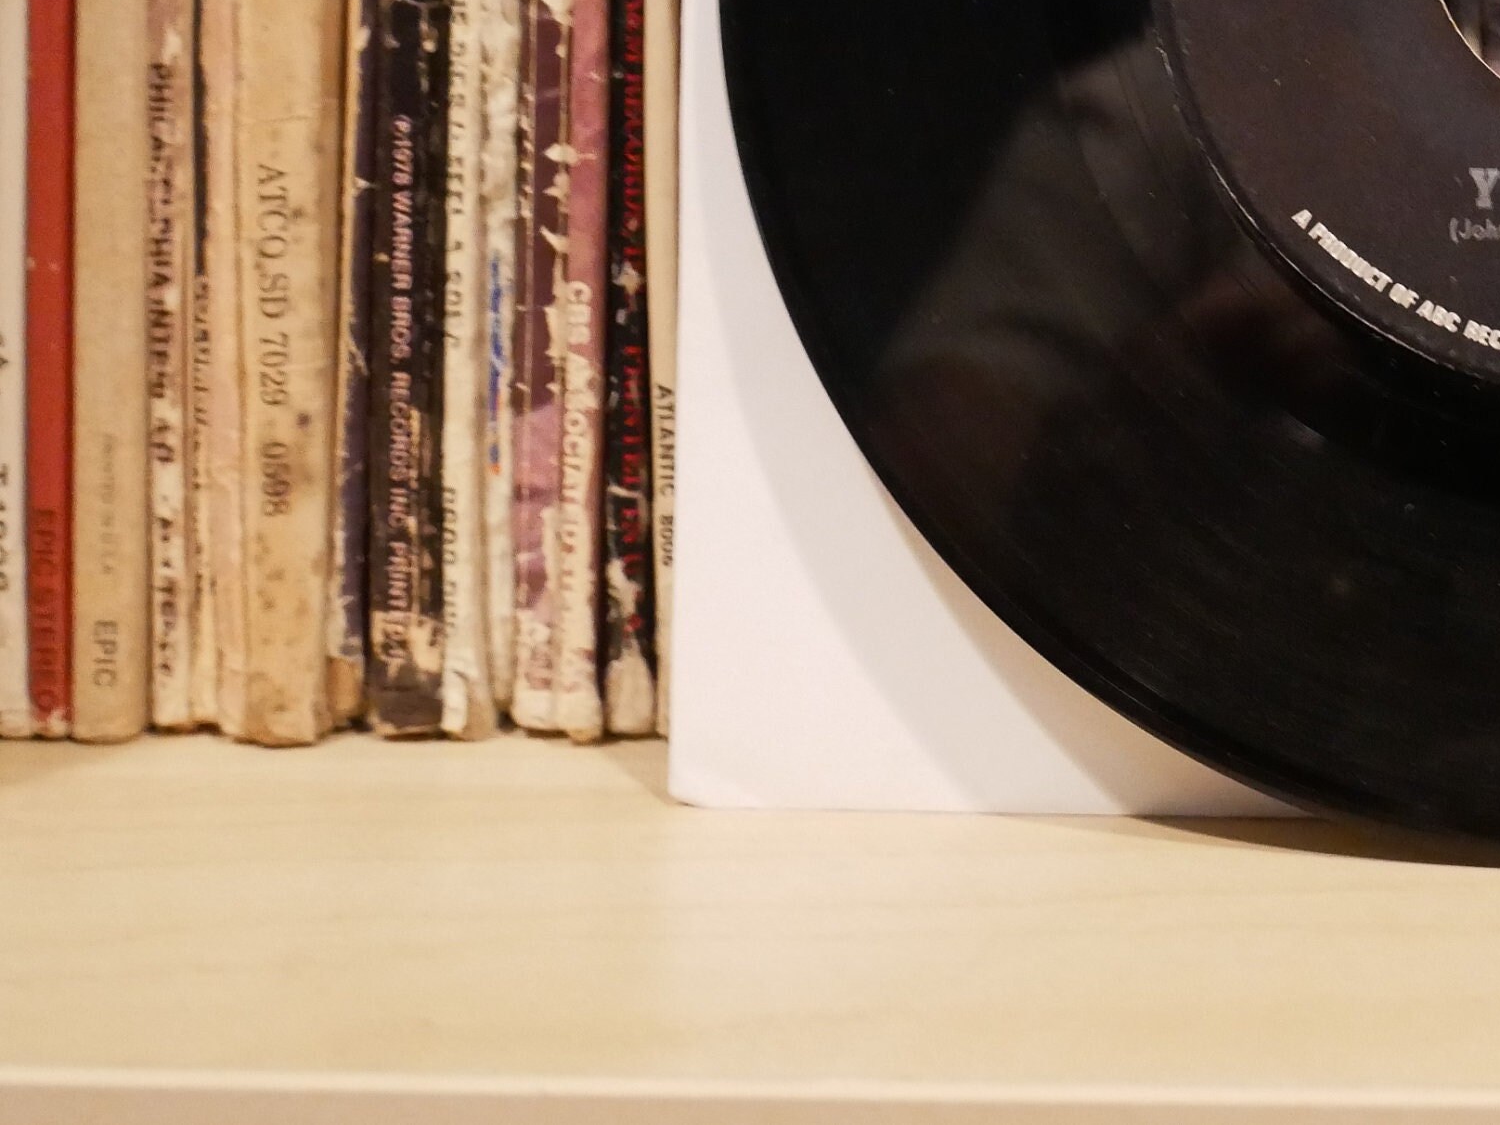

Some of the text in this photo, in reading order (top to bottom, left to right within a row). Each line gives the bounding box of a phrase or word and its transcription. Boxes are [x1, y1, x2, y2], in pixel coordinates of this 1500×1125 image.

[390, 189, 413, 290] WARNER
[1291, 208, 1314, 231] A
[1308, 221, 1394, 294] PRODUCT
[1388, 282, 1421, 310] OF
[1415, 299, 1462, 334] ABC
[258, 272, 292, 320] SD
[258, 331, 291, 406] 7029
[388, 371, 412, 481] RECORDS
[655, 383, 676, 496] ATLANTIC
[31, 507, 60, 573] EPIC
[92, 619, 119, 688] EPIC
